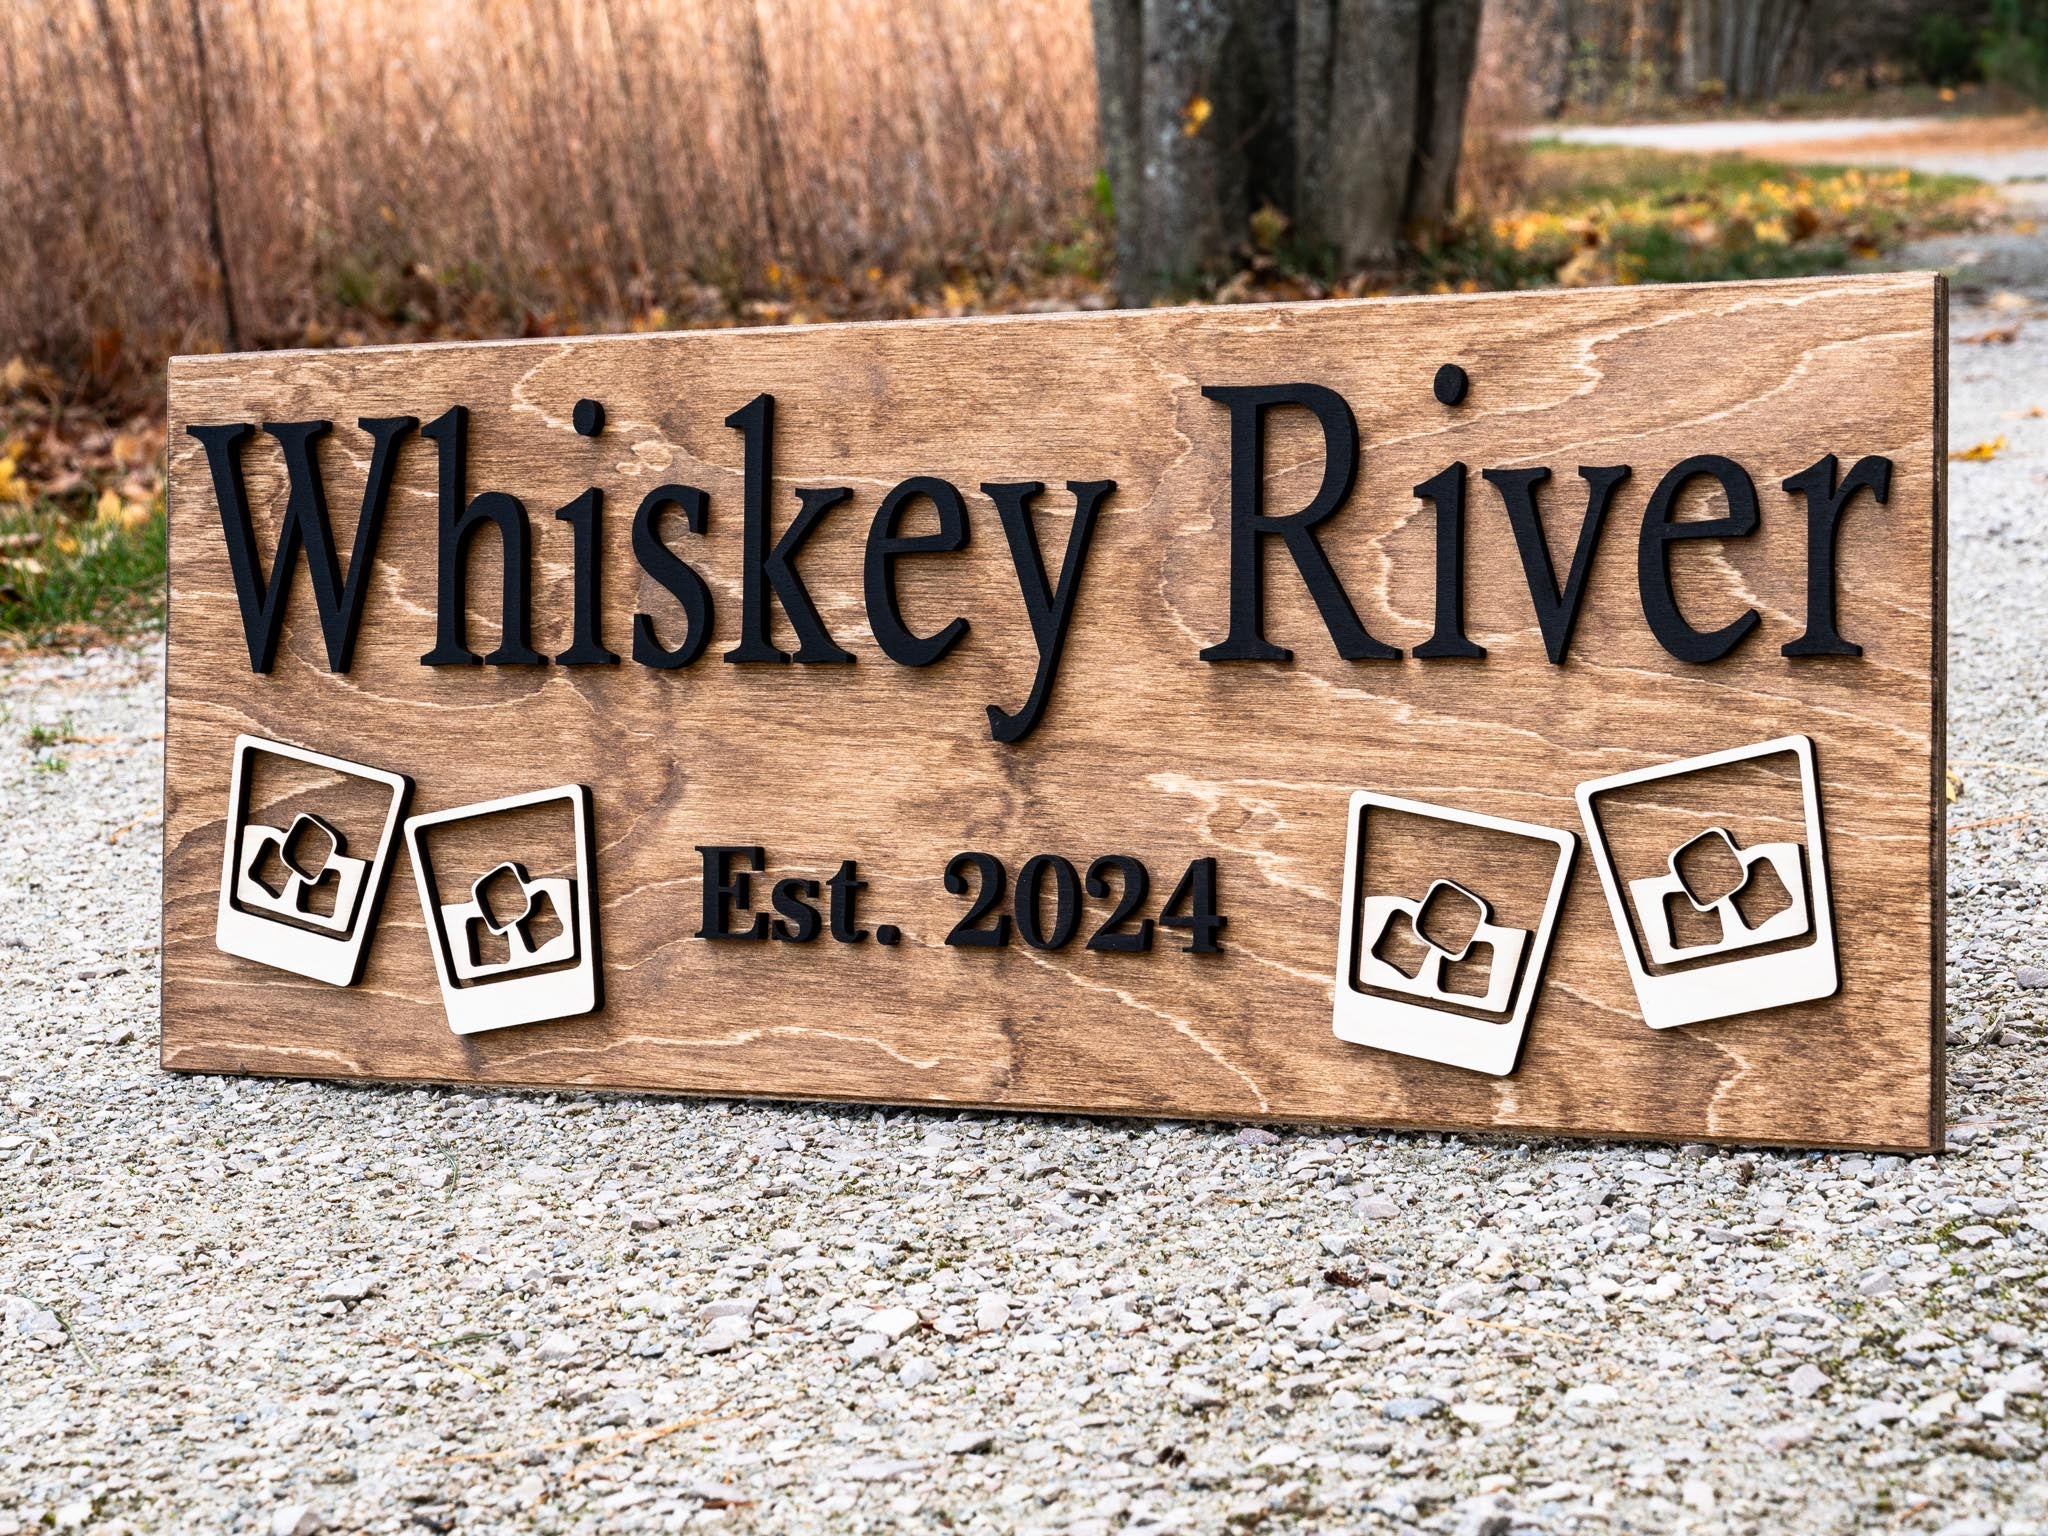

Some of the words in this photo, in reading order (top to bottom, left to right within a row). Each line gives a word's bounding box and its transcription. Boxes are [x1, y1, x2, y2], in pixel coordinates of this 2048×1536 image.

[186, 393, 1118, 748] Whiskey
[1199, 363, 1894, 668] River
[694, 845, 903, 948] Est.
[943, 851, 1229, 958] 2024
